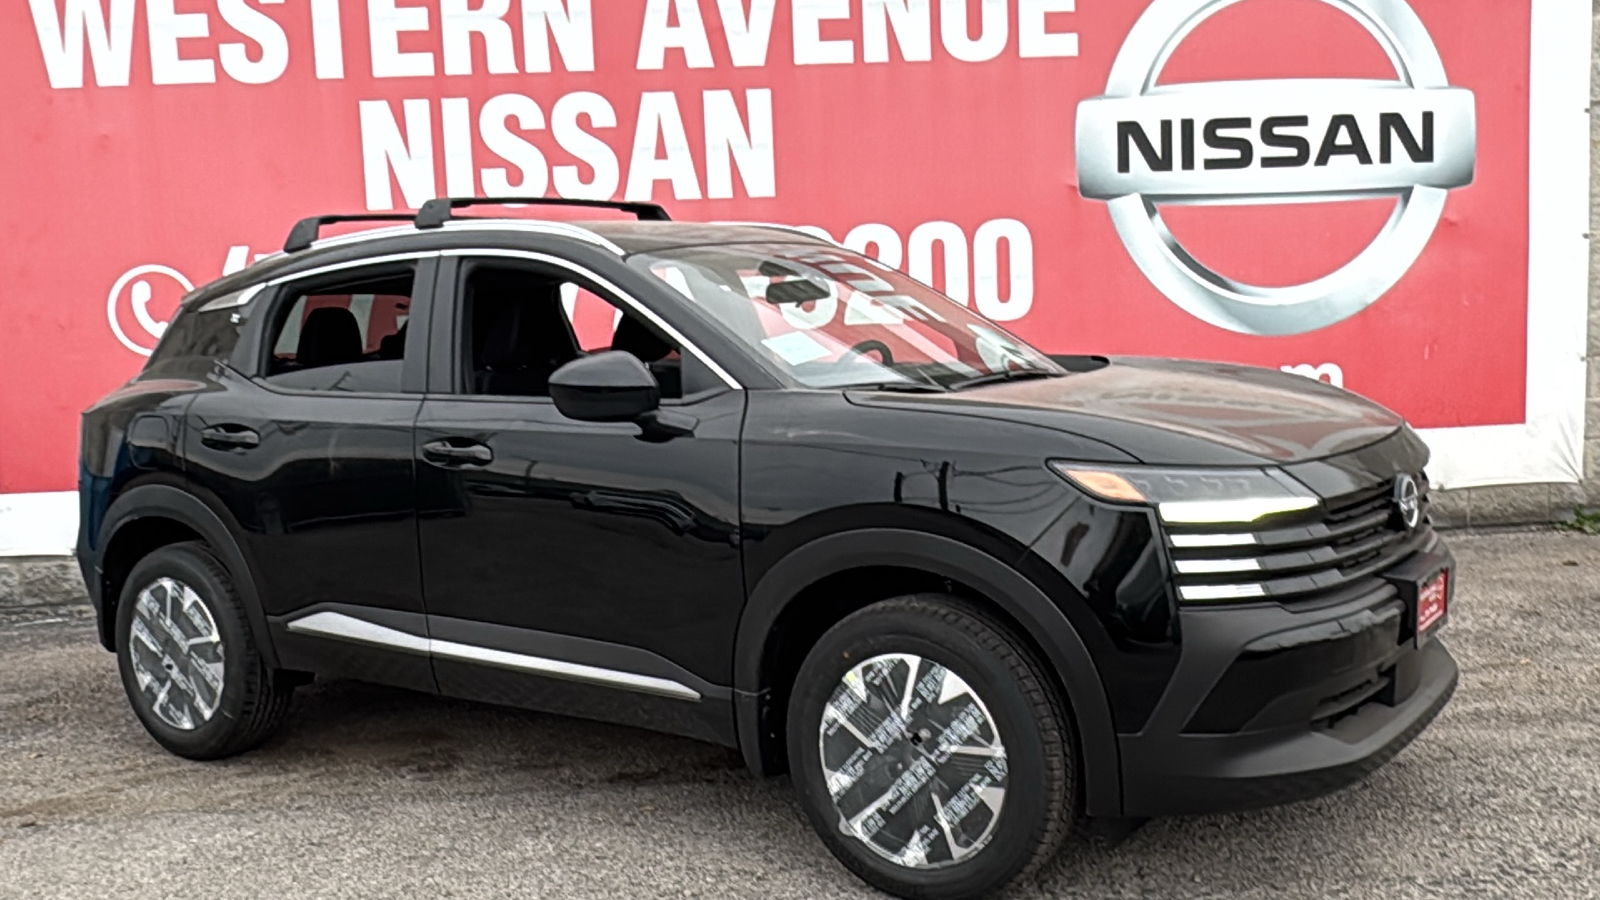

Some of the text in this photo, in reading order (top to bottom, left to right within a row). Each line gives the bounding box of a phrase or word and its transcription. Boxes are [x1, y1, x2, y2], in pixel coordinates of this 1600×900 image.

[28, 0, 1079, 89] WESTERN AVENUE
[358, 88, 776, 212] NISSAN
[1117, 111, 1433, 172] NISSAN
